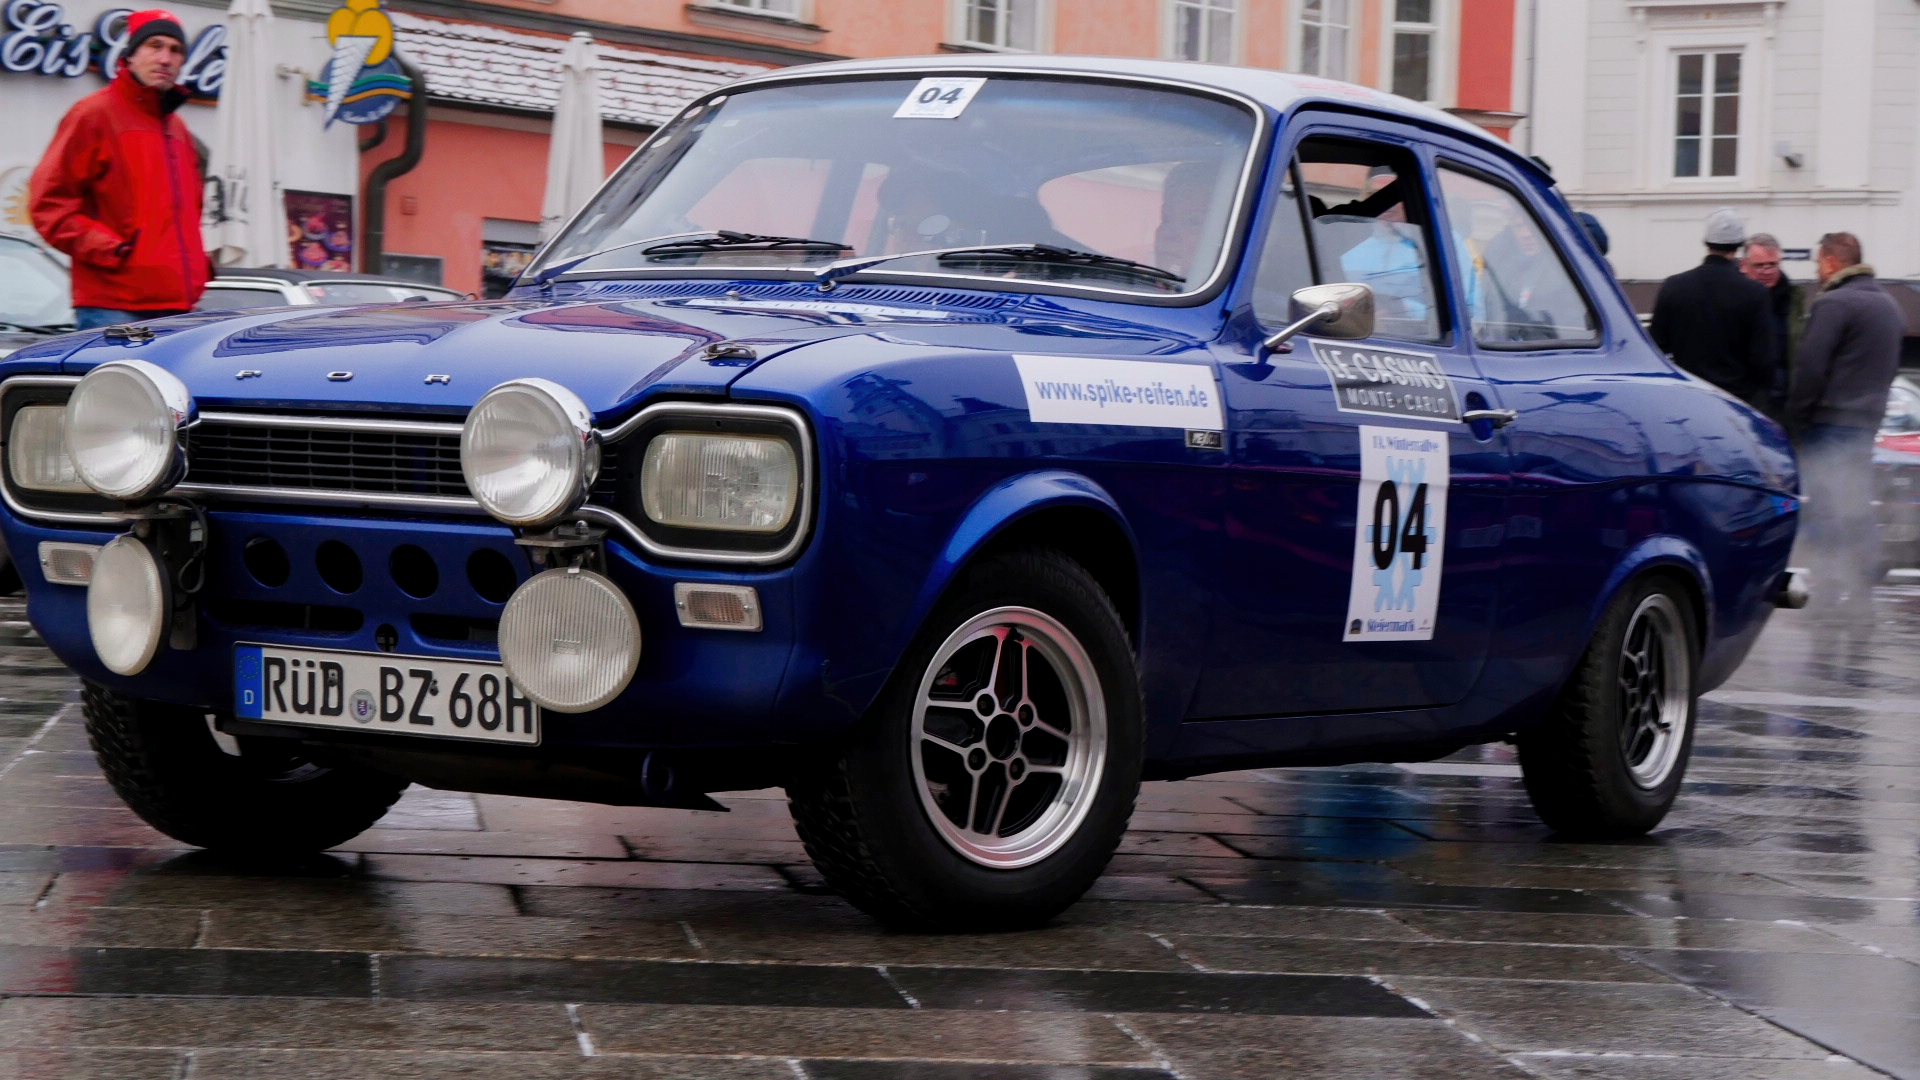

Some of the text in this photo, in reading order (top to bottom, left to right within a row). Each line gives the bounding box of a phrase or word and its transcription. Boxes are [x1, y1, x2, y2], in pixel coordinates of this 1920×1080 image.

[0, 0, 92, 77] Eis
[919, 87, 964, 104] 04
[1319, 349, 1446, 390] LE CASINO
[1034, 378, 1209, 409] www.spike-reifen.de
[1373, 479, 1428, 570] 04
[244, 689, 254, 705] D
[379, 666, 434, 726] BZ
[449, 672, 532, 734] 68H
